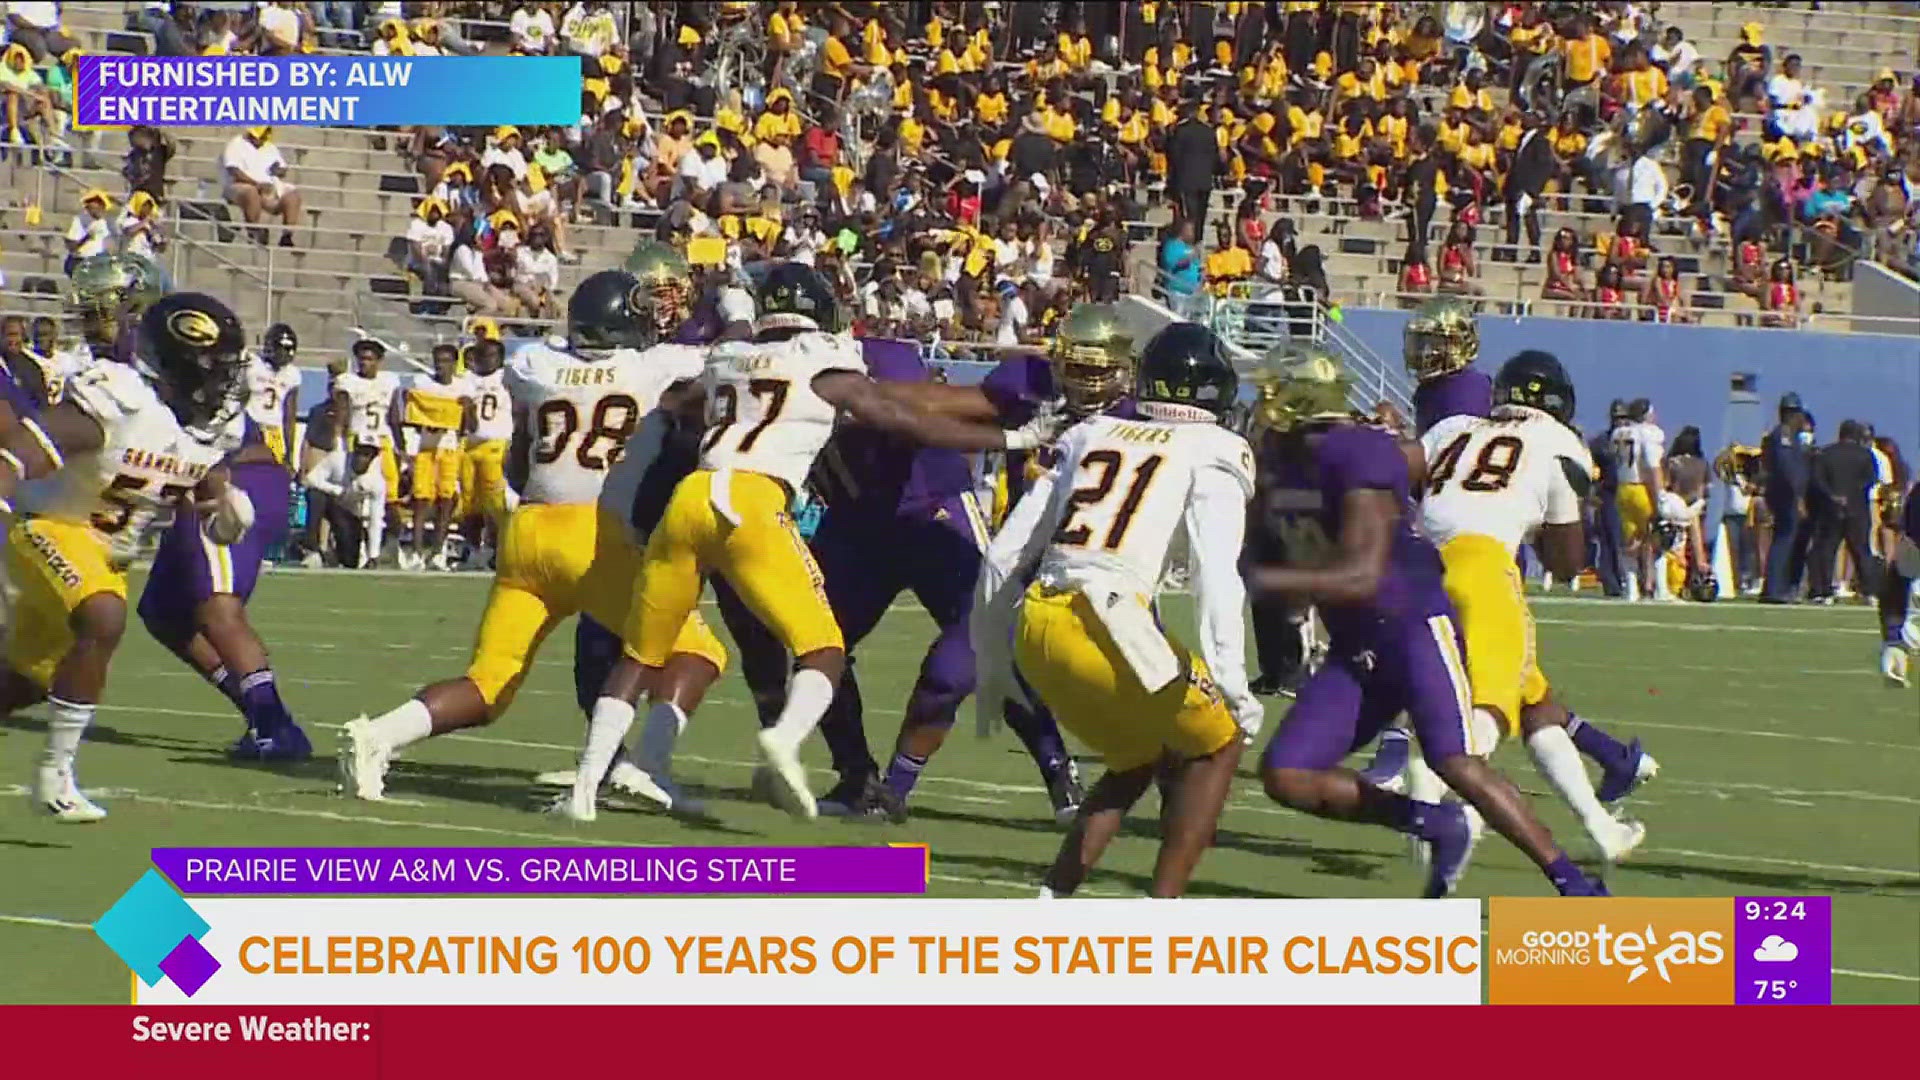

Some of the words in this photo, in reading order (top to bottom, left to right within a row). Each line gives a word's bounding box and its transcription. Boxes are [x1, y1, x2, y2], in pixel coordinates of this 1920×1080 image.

[555, 366, 617, 386] TIGERS
[1428, 432, 1524, 497] 48
[1050, 450, 1163, 549] 21
